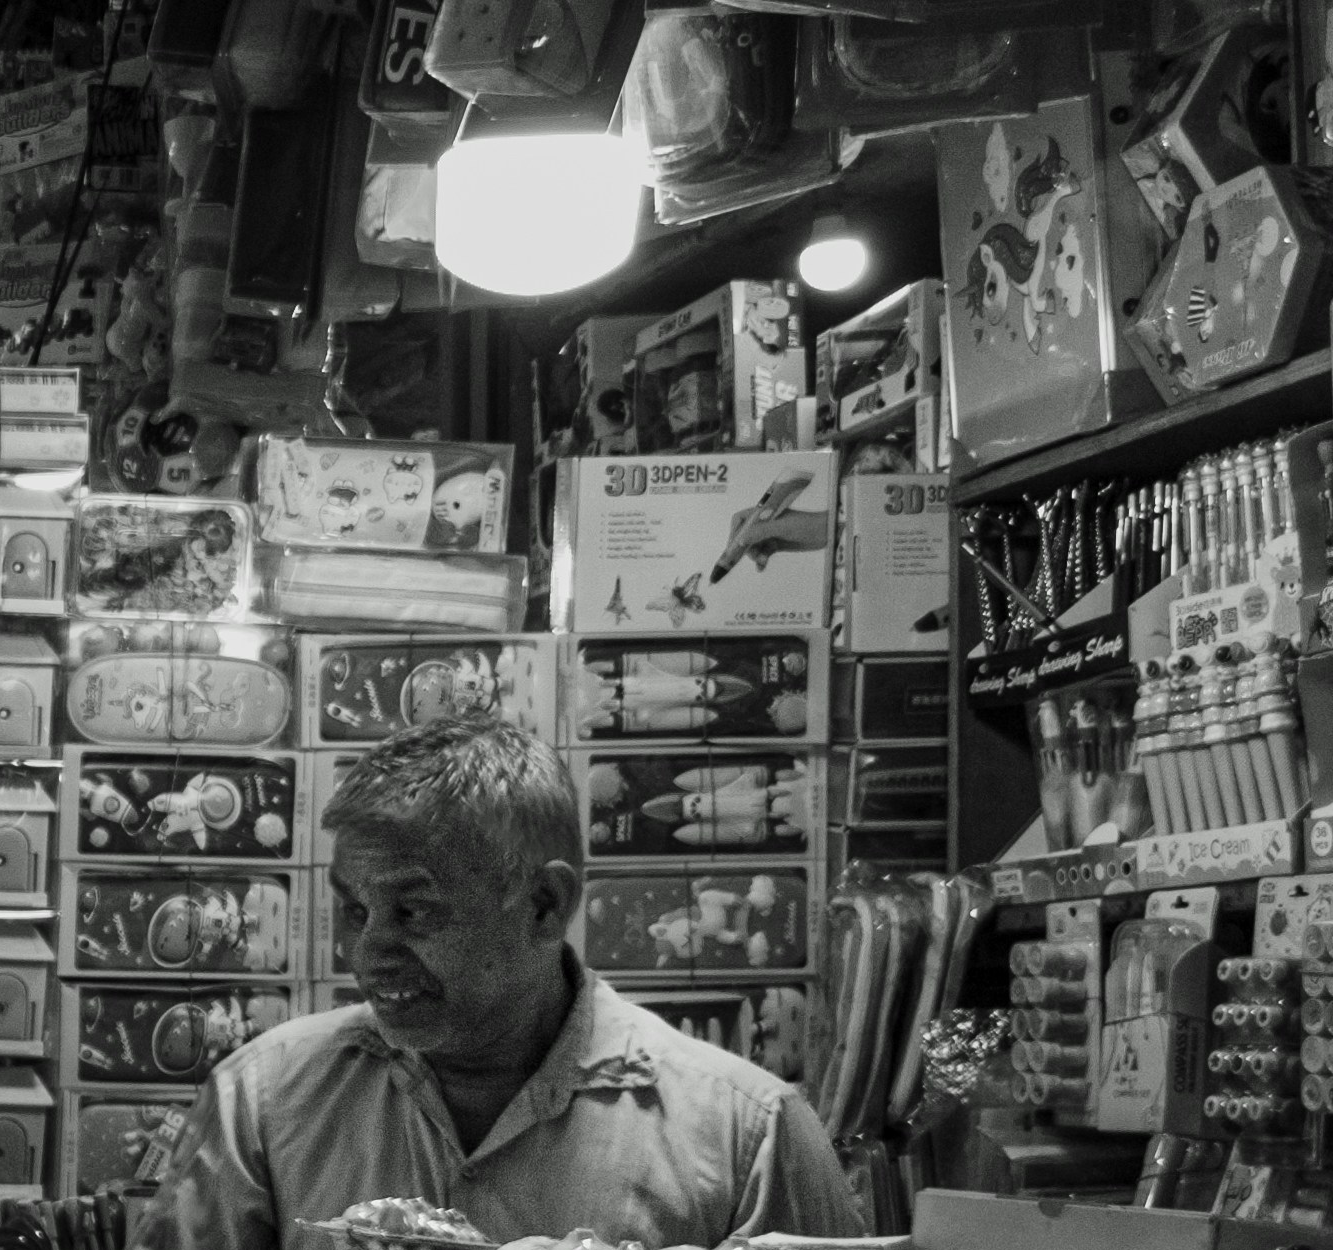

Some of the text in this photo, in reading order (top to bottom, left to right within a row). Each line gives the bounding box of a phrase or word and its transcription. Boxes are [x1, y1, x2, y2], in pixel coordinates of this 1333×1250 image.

[604, 463, 729, 497] 3D 3DPEN-2
[884, 485, 924, 516] 3D
[1188, 838, 1250, 863] Ice Cream
[1173, 1033, 1189, 1093] COMPASS
